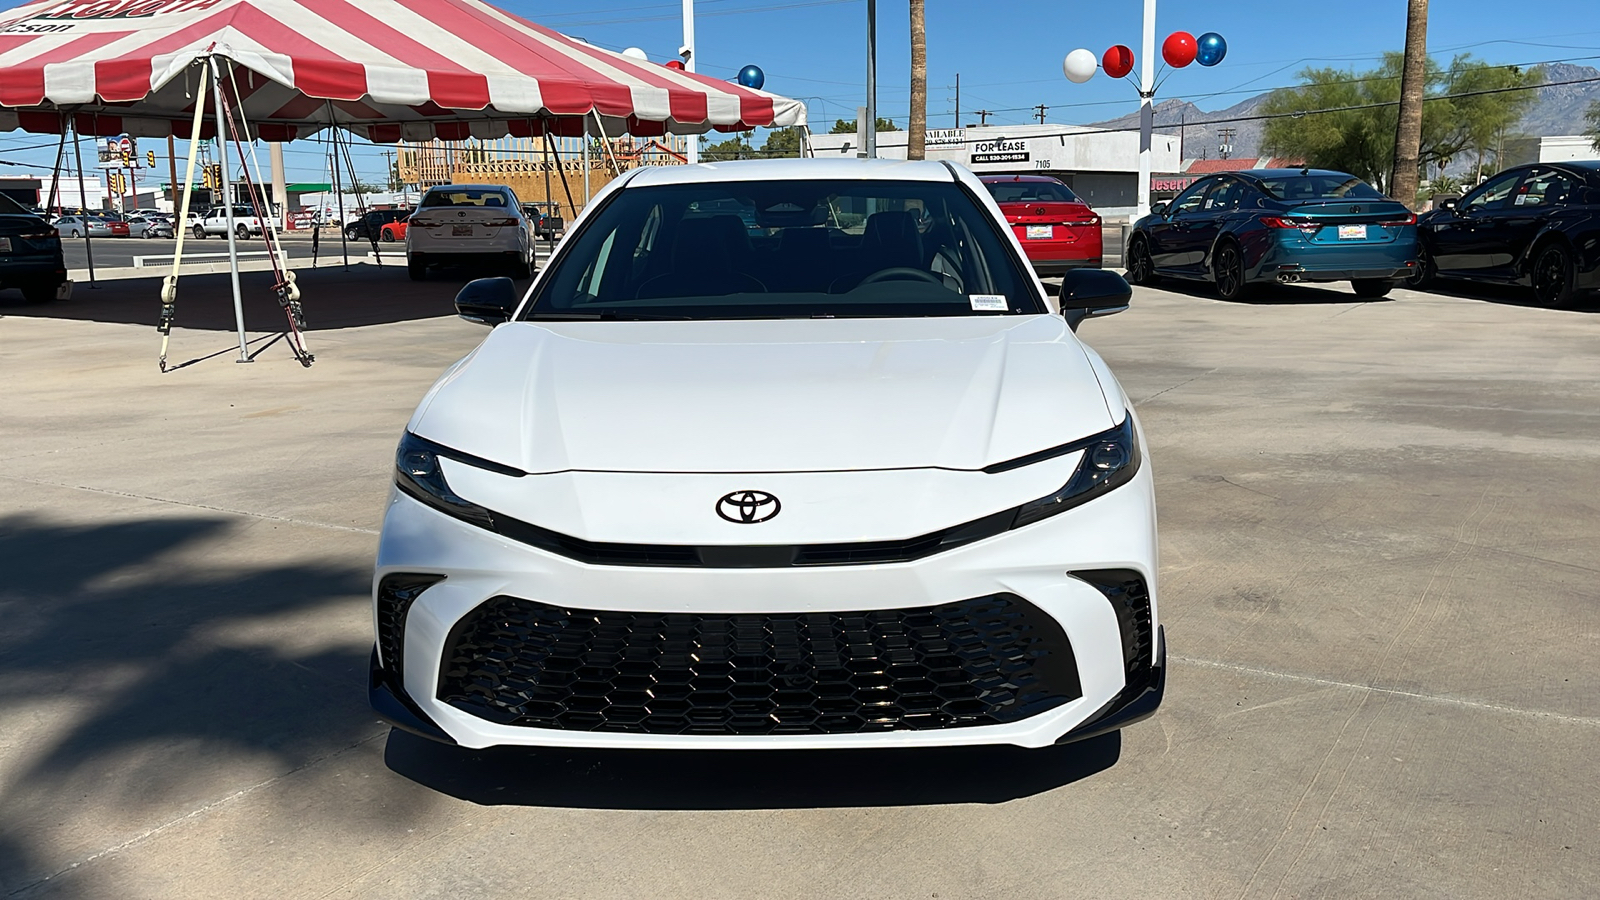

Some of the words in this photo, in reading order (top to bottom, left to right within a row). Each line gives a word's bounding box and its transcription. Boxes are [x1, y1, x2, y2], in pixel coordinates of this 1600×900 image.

[924, 130, 964, 139] VAILABLE
[975, 143, 995, 152] FOR
[997, 141, 1026, 152] LEASE
[1035, 159, 1051, 169] 7105
